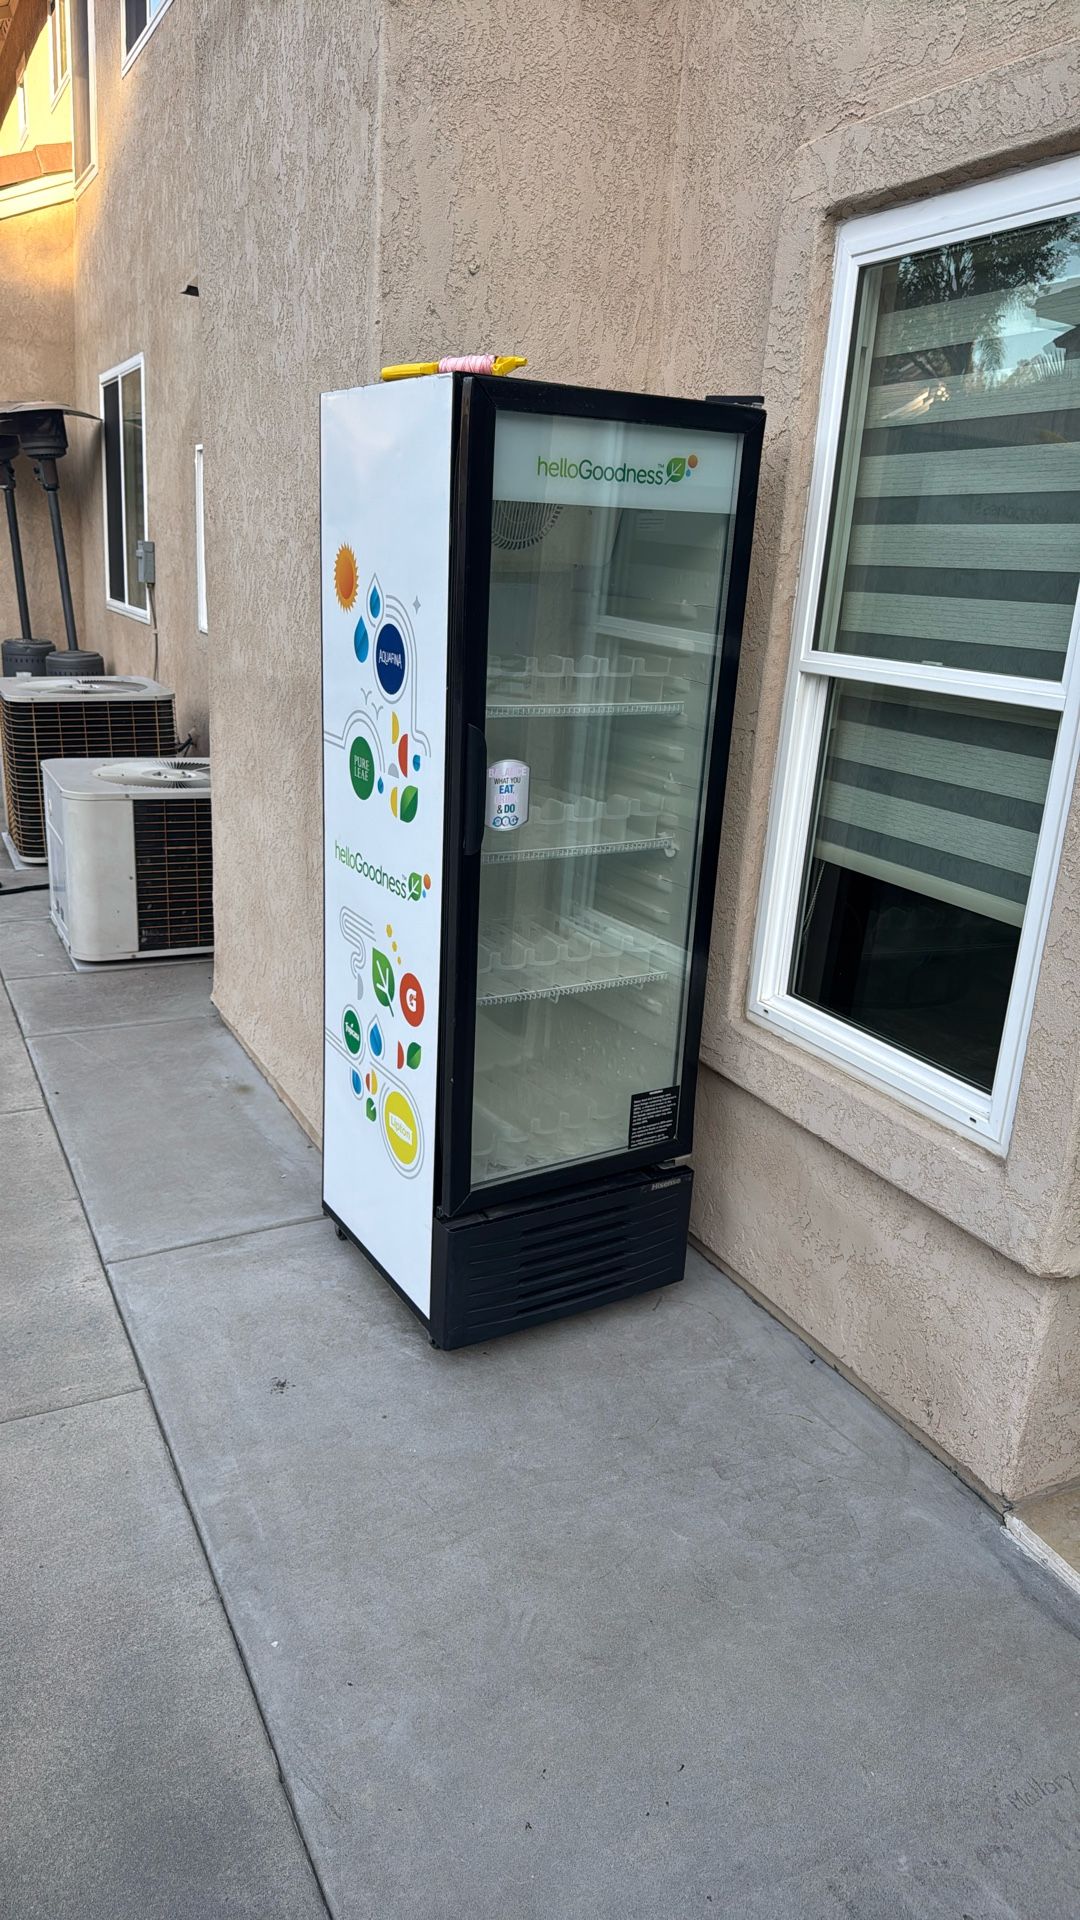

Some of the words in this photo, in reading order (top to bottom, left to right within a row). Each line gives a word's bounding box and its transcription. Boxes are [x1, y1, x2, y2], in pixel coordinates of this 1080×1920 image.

[536, 455, 664, 486] helloGoodness
[378, 649, 402, 668] AQUAFINA
[353, 754, 370, 771] PURE
[497, 805, 502, 814] &
[504, 804, 515, 813] DO
[334, 839, 407, 900] helloGoodness
[390, 1114, 411, 1140] Lipton
